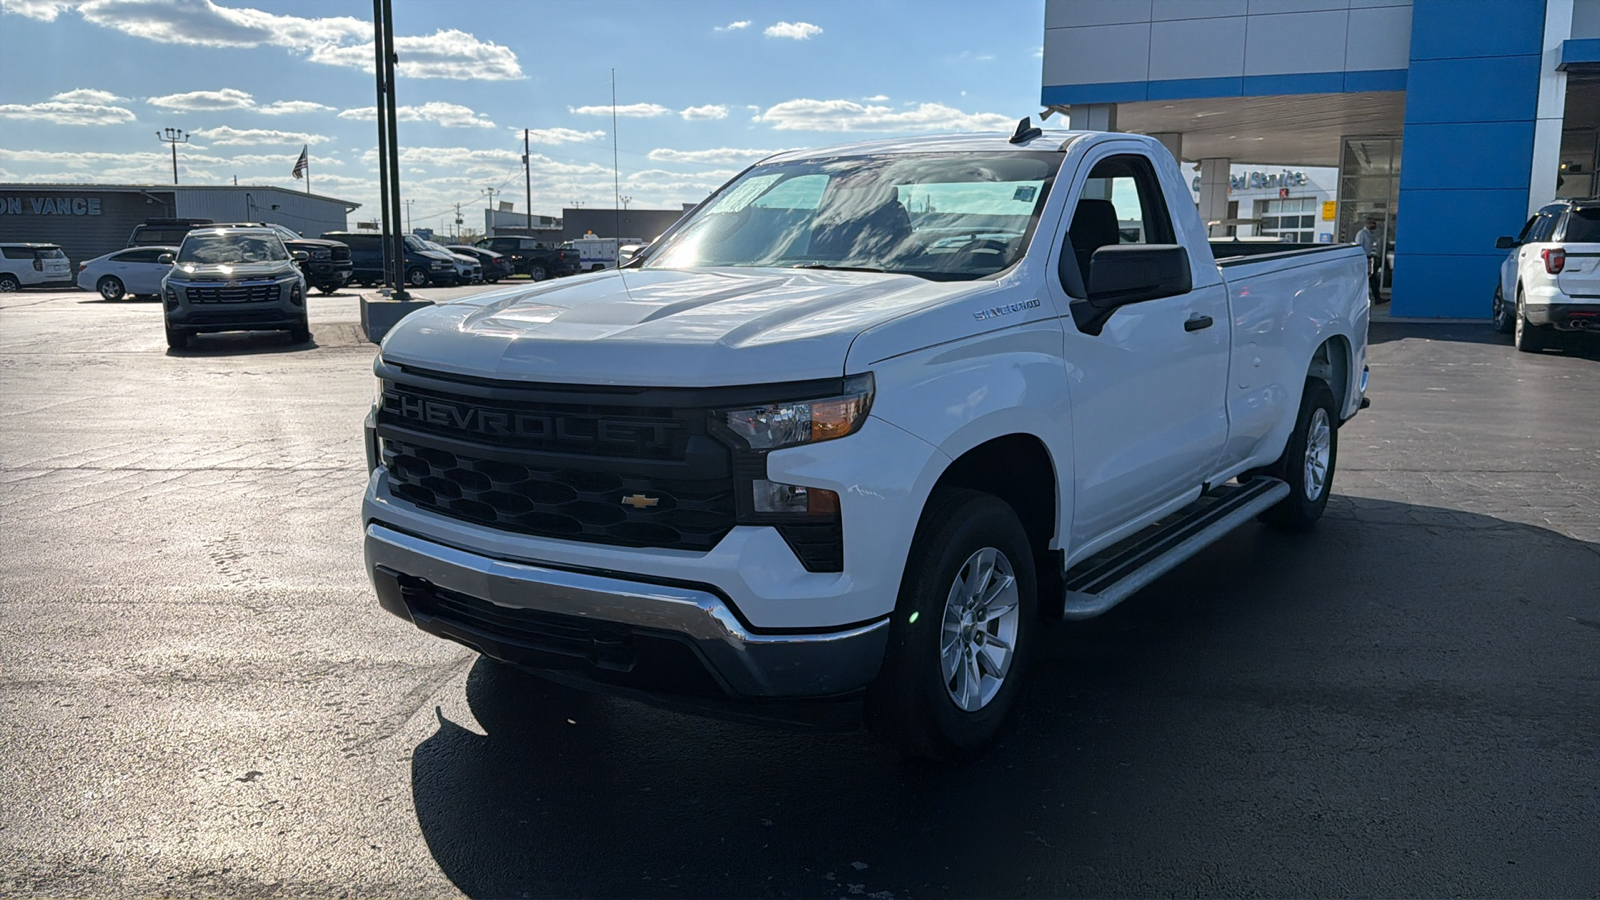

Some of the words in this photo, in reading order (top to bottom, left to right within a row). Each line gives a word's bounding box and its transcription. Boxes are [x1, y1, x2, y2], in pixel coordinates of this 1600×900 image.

[1252, 168, 1307, 189] Service
[31, 197, 101, 215] VANCE
[974, 298, 1041, 320] SILVERADO
[382, 392, 682, 445] CHEVROLET
